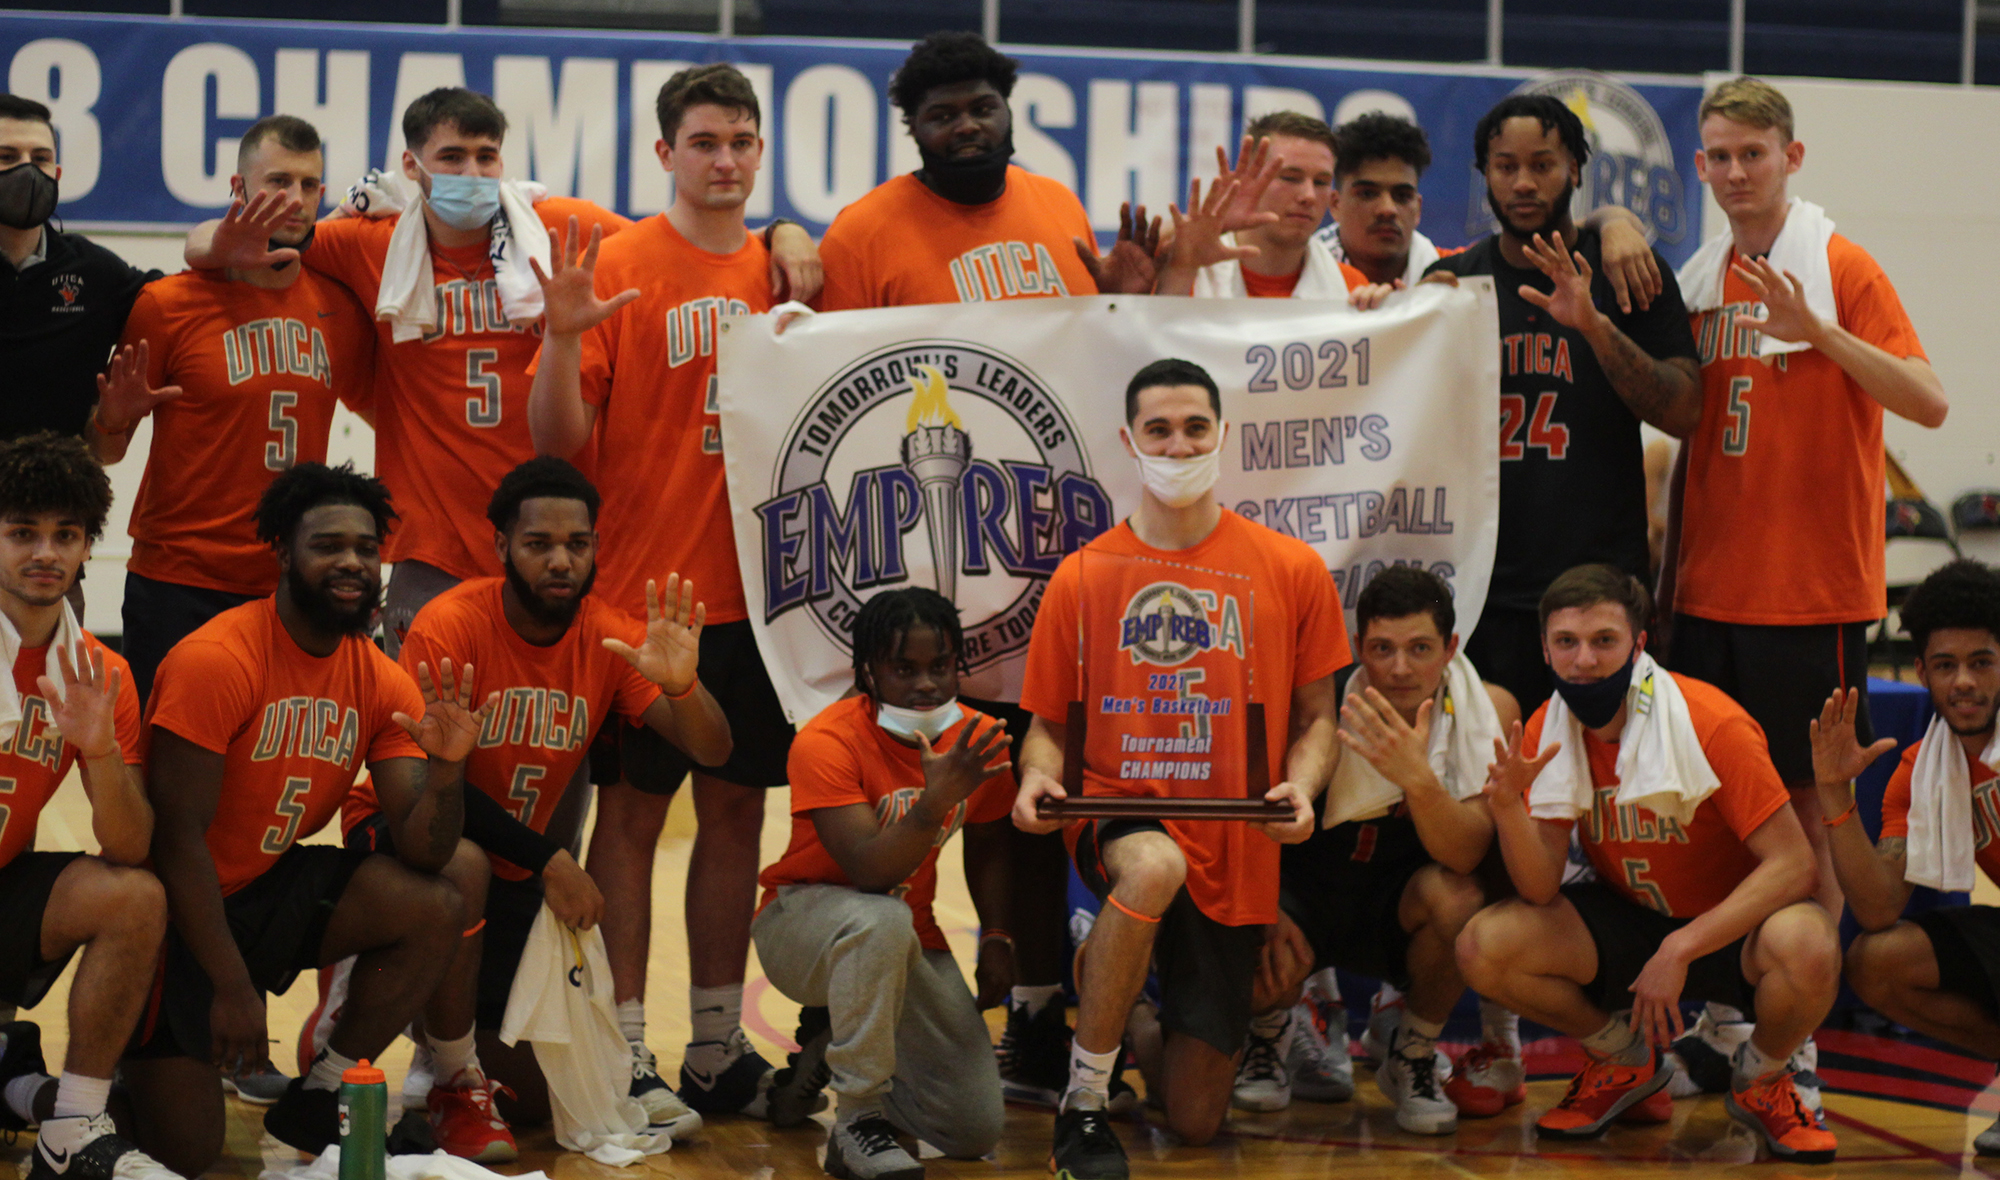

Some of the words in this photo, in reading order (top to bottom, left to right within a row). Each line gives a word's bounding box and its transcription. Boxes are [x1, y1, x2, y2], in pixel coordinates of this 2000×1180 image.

[161, 43, 1419, 232] CHMOSHI
[949, 240, 1070, 303] UTICA
[423, 278, 544, 345] UTIC
[223, 317, 331, 388] UTICA
[1245, 337, 1370, 393] 2021
[1499, 332, 1574, 385] TICA
[466, 348, 501, 428] 5
[976, 361, 1066, 451] LEADERS
[1722, 376, 1753, 457] 5
[264, 390, 298, 472] 5
[1241, 413, 1392, 472] MEN'S
[1500, 391, 1570, 461] 24
[1219, 486, 1454, 545] KETBALL
[1101, 695, 1146, 714] Men's
[1151, 696, 1232, 715] Basketball
[1147, 674, 1185, 691] 2021
[251, 695, 360, 771] UTICA
[477, 686, 589, 752] UTICA
[1121, 733, 1213, 754] Tournament
[1120, 760, 1213, 780] CHAMPIONS
[260, 776, 312, 855] 5
